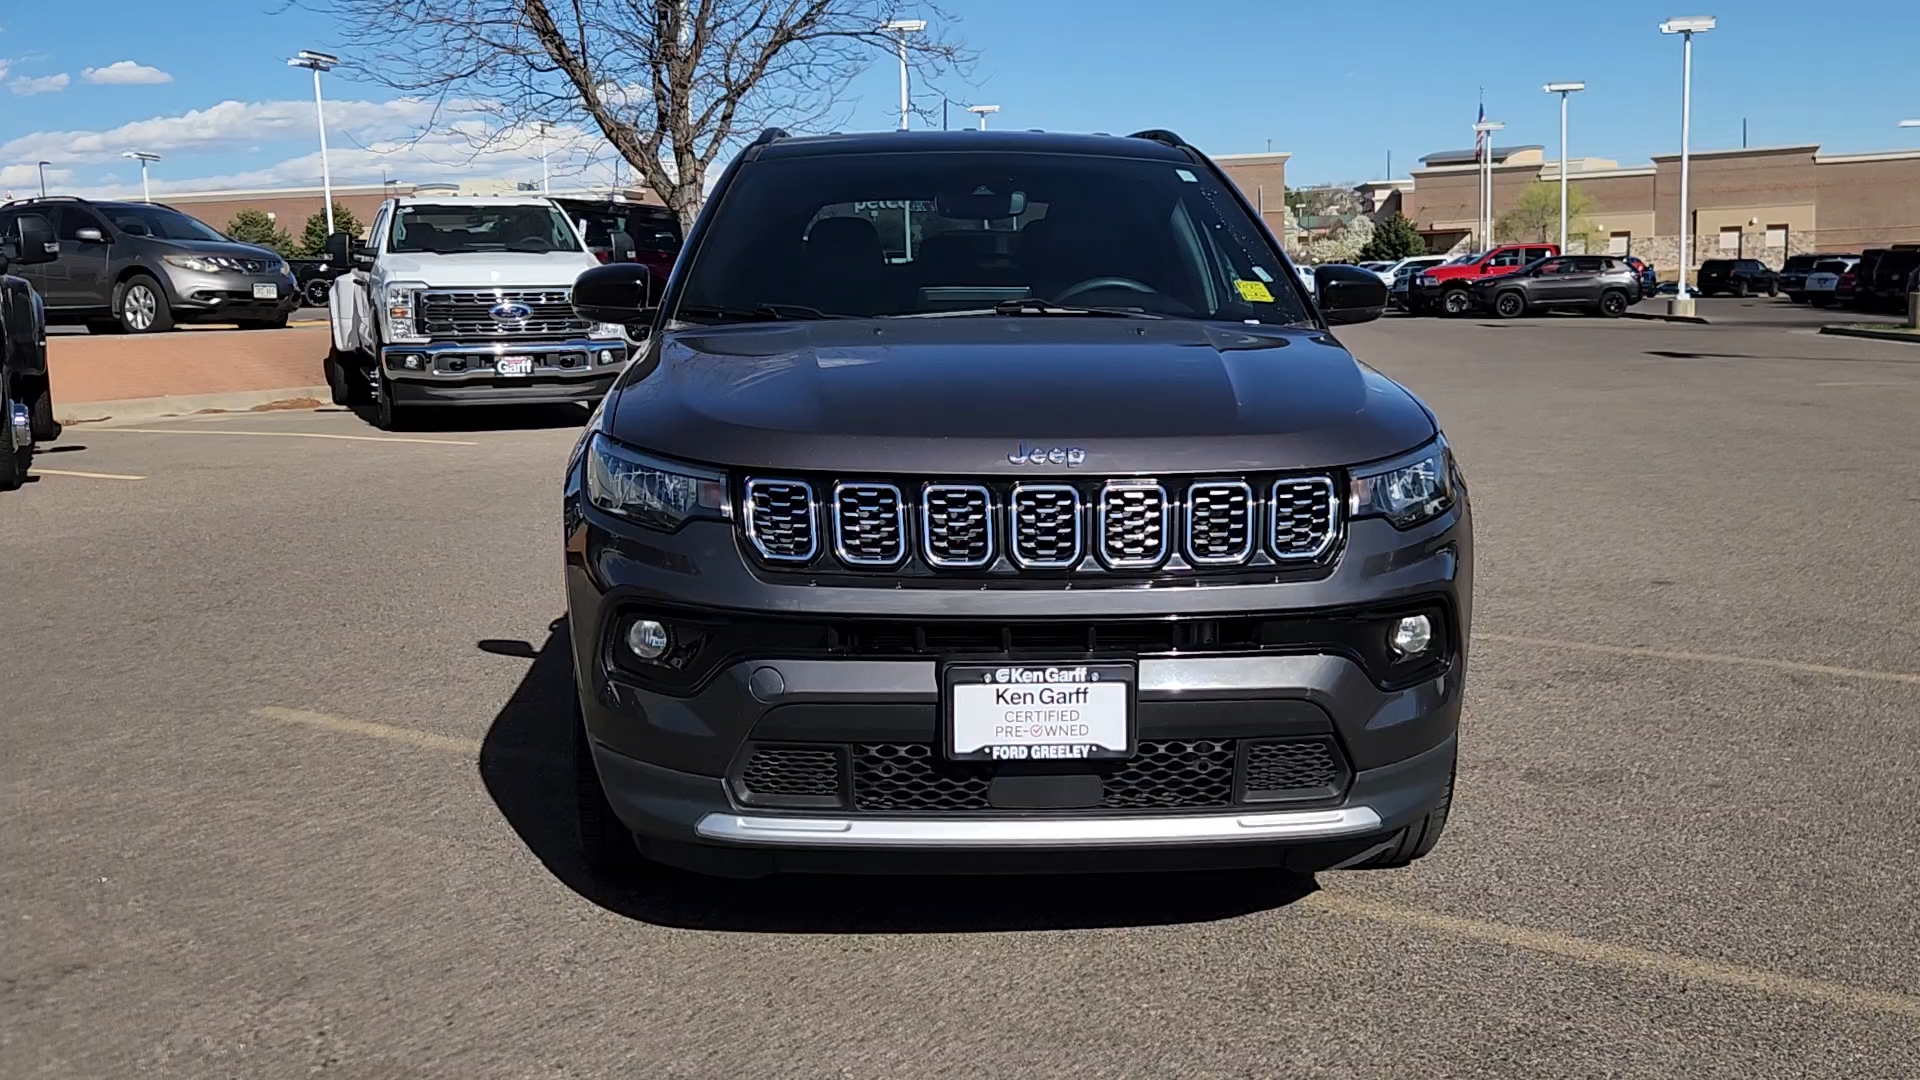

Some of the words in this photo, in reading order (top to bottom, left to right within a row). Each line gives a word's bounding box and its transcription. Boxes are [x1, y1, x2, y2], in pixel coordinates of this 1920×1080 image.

[497, 360, 532, 373] Garff
[1007, 442, 1086, 468] Jeep
[1011, 668, 1043, 683] Ken
[1045, 667, 1087, 682] Garff
[995, 687, 1034, 705] Ken
[1039, 687, 1089, 705] Garff
[1004, 709, 1080, 723] CERTIFIED
[995, 724, 1089, 738] PRE-OWNED
[992, 746, 1028, 760] FORD
[1031, 744, 1090, 759] GREELEY
